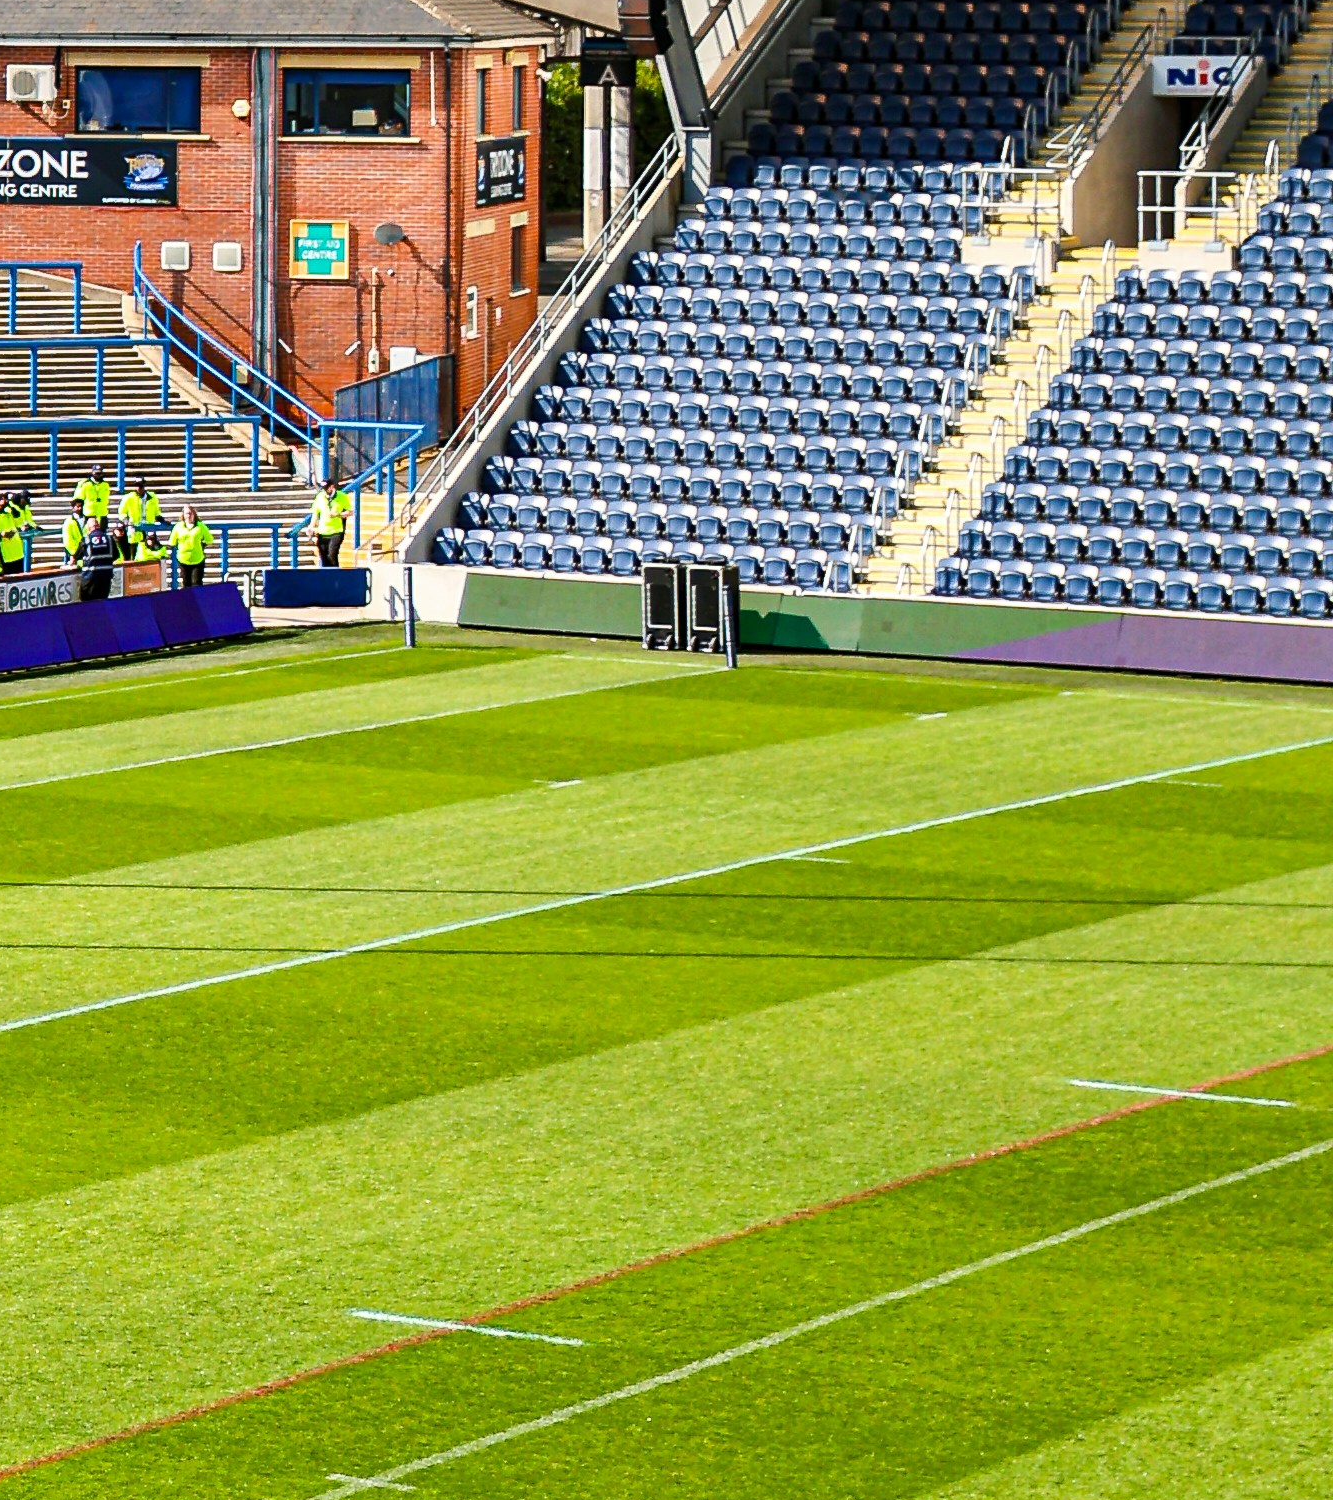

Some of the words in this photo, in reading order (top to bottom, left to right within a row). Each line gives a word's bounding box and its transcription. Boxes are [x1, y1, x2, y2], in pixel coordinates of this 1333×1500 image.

[29, 183, 77, 199] CENTRE
[298, 239, 323, 248] FIRST
[326, 239, 340, 249] AID
[301, 250, 337, 260] CENTRE
